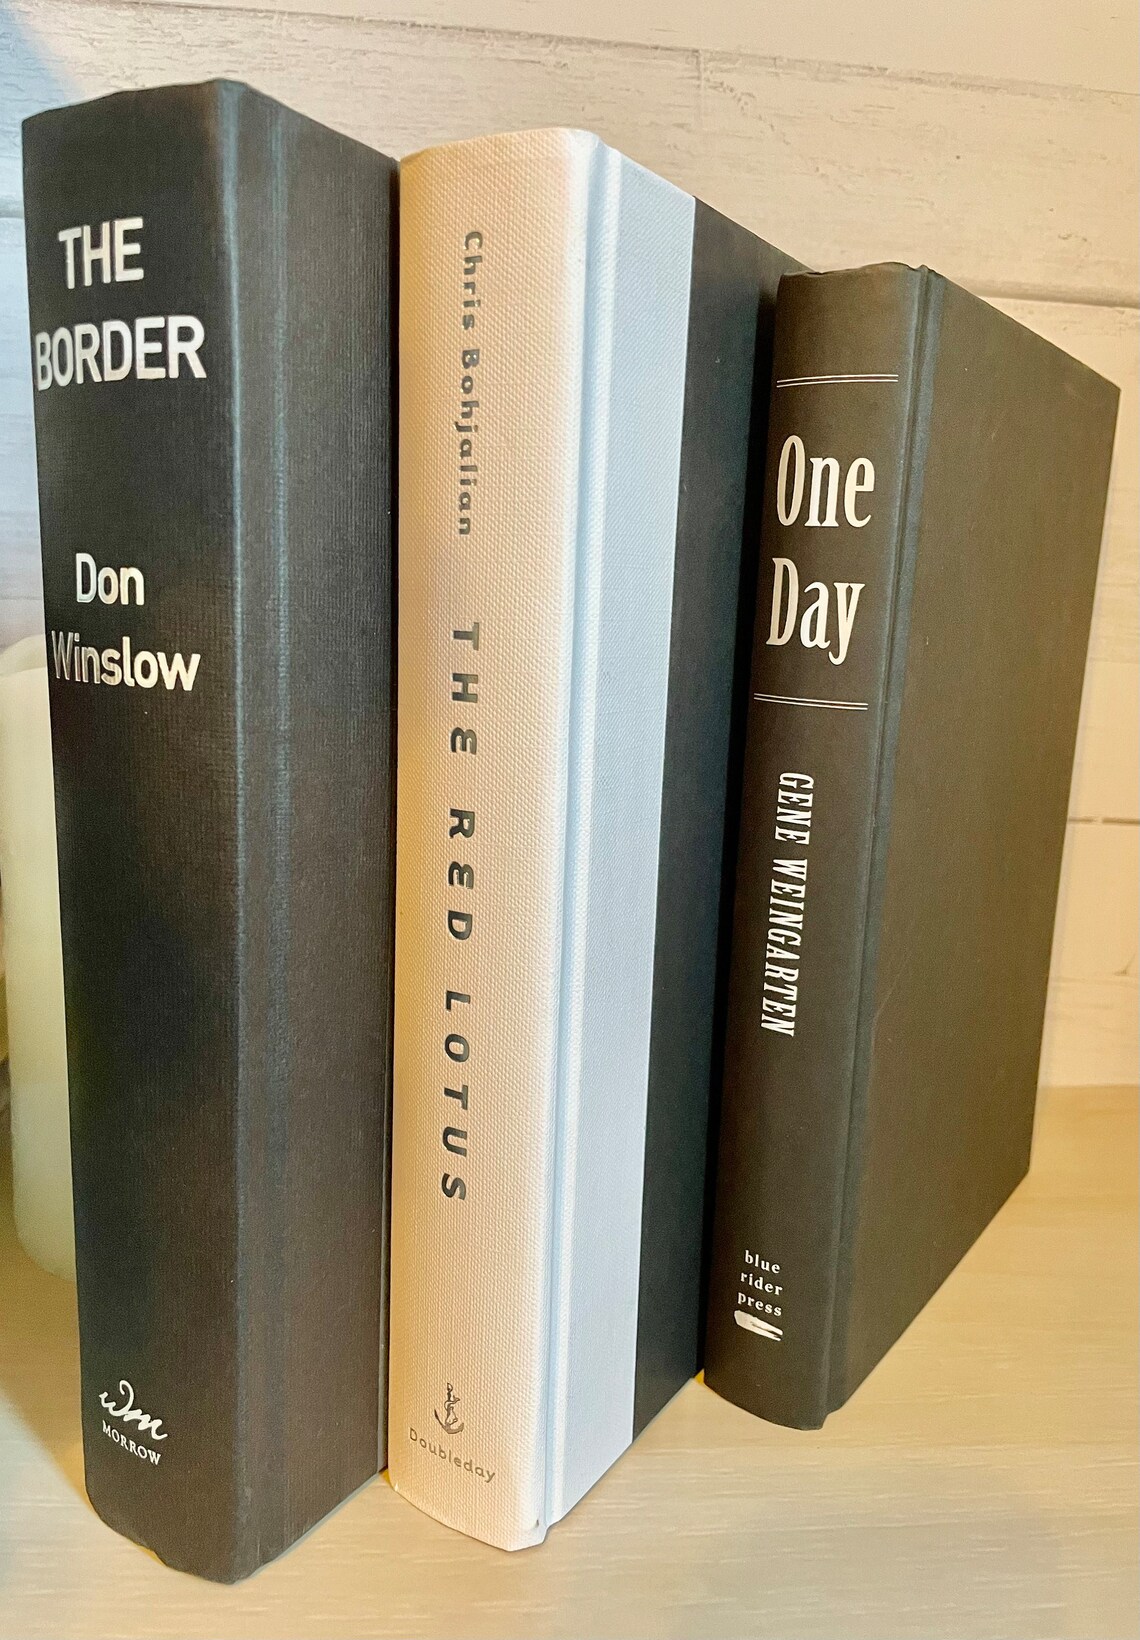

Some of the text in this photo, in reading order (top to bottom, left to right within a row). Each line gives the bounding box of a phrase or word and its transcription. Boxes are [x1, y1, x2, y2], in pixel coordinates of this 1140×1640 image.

[58, 216, 145, 289] THE
[35, 315, 207, 391] BORDER
[454, 231, 483, 535] Chris Bohjalian
[776, 434, 875, 528] One
[75, 552, 145, 605] Don
[766, 557, 866, 665] Day
[51, 629, 200, 691] Winslow
[441, 621, 480, 1200] THE RED LOTUS
[760, 772, 815, 1037] GENE WEINGARTEN
[740, 1272, 783, 1295] rider
[745, 1249, 780, 1274] blue
[737, 1292, 782, 1316] press
[102, 1420, 161, 1465] MORROW
[409, 1427, 495, 1483] Doubleday
